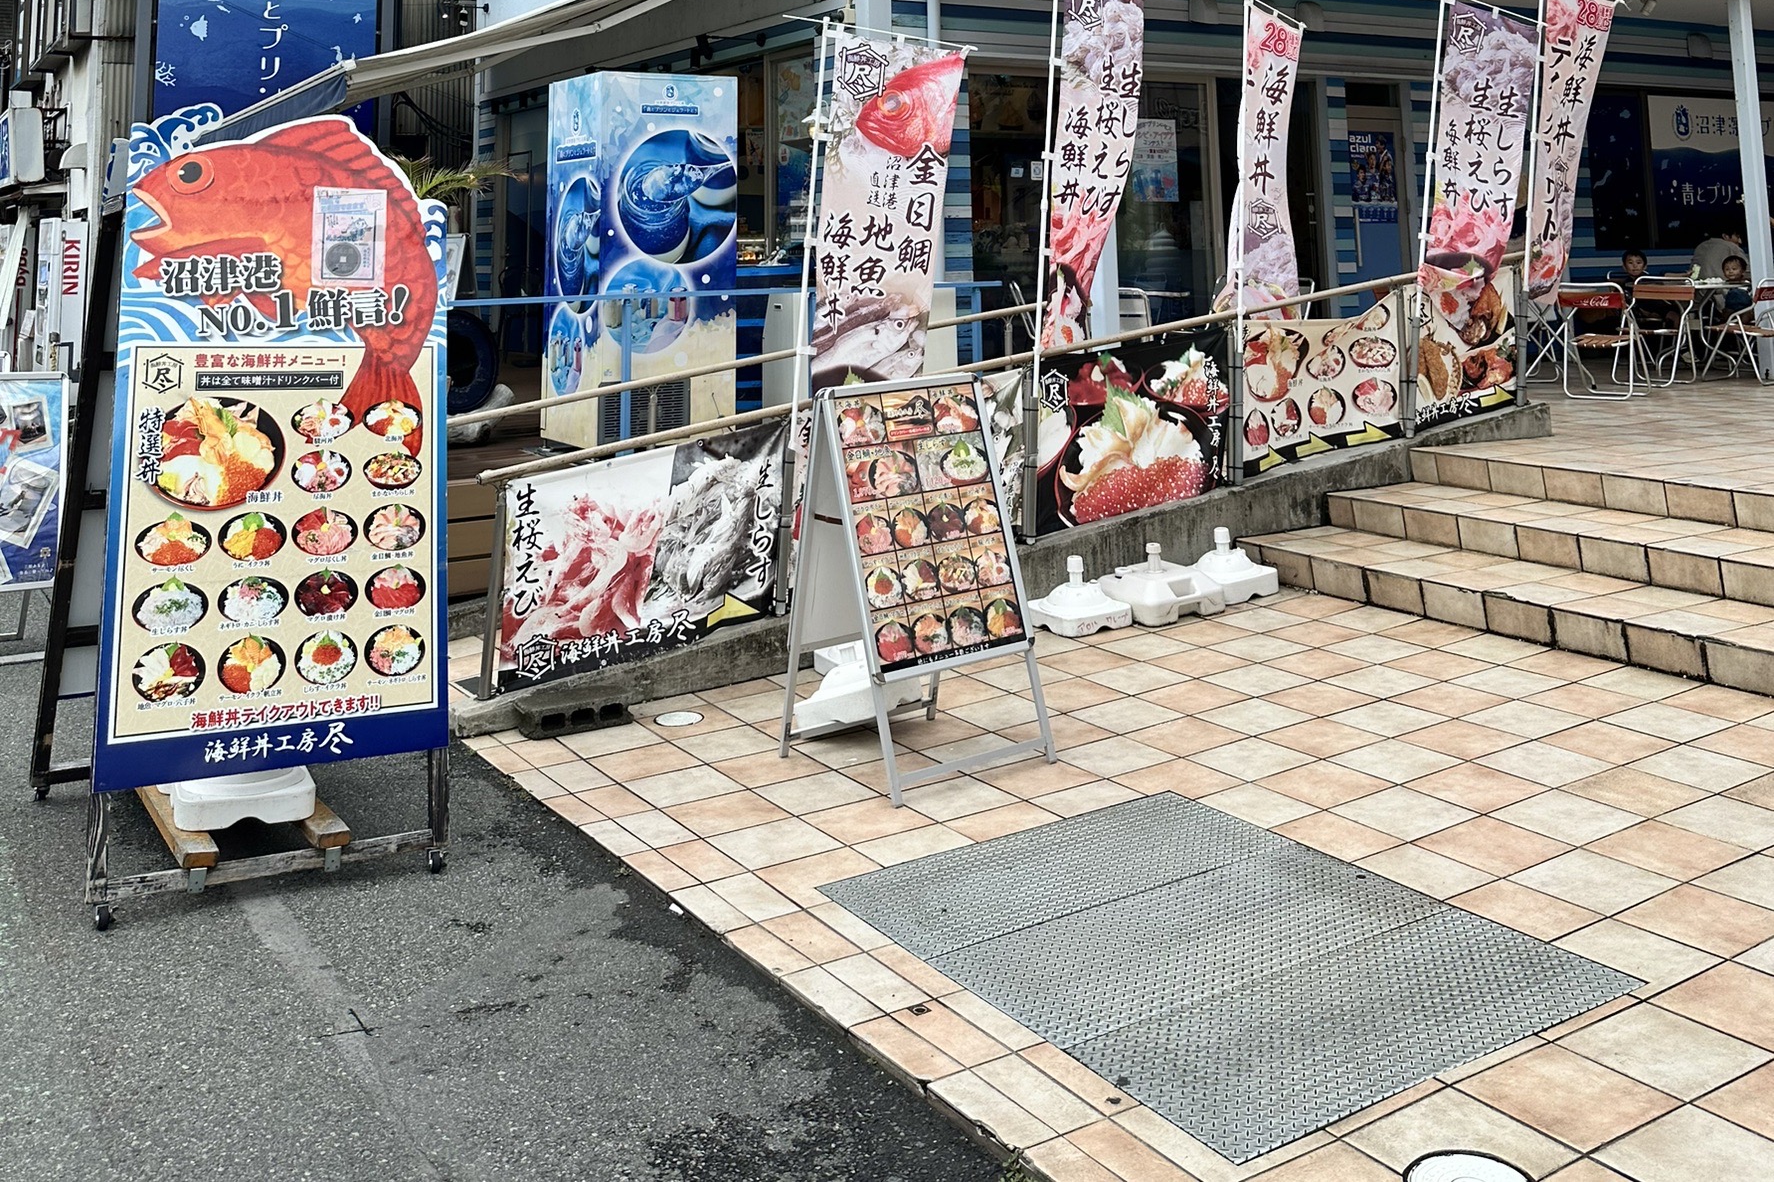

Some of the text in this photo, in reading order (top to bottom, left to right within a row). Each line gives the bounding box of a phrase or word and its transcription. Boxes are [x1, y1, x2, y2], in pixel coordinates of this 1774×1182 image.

[1260, 22, 1288, 58] 28
[1082, 54, 1121, 217] 生桜えび
[1249, 64, 1290, 196] 海鮮丼
[1552, 34, 1597, 155] 海鮮丼
[1053, 104, 1093, 213] 海鮮丼
[1098, 62, 1142, 219] 生しらす
[1349, 134, 1372, 144] azul
[1464, 77, 1493, 213] 生桜えび
[1493, 84, 1520, 223] 生しらす
[866, 170, 881, 208] 直送
[882, 155, 902, 211] 沼津港
[894, 143, 945, 276] 金目鯛
[61, 239, 81, 296] KIRIN
[161, 255, 281, 295] 沼津港
[821, 212, 858, 335] 海鮮丼
[850, 213, 896, 299] 地魚
[152, 367, 174, 389] 尽
[201, 373, 340, 387] 丼は全て味噌汁・ドリンクバー付
[136, 408, 165, 485] 特選丼
[247, 491, 283, 504] 海鮮丼
[746, 460, 774, 589] 生しらす
[511, 483, 543, 617] 生桜えび
[151, 626, 188, 636] 生しらす丼
